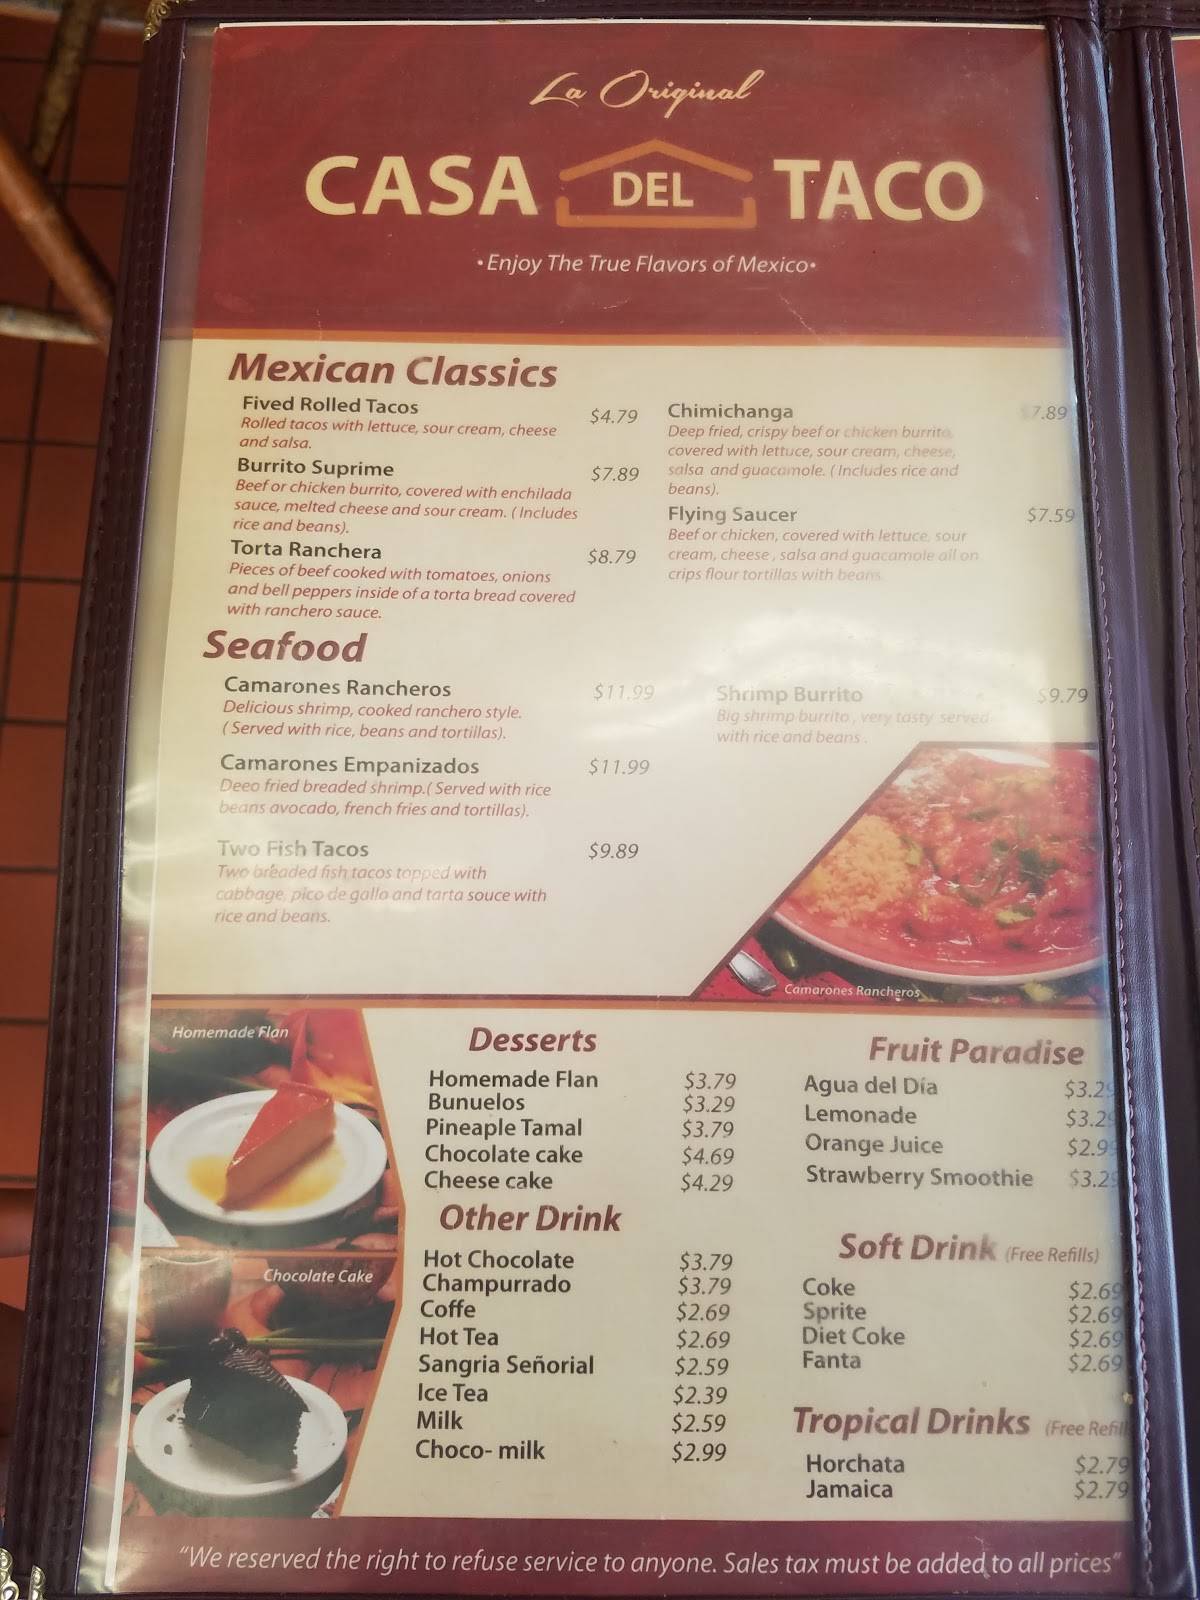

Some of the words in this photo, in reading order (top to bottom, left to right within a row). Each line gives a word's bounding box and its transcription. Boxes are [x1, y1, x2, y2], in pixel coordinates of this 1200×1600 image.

[529, 72, 586, 106] La
[600, 70, 764, 118] Original
[306, 156, 536, 215] CASA
[612, 170, 694, 207] DEL
[774, 160, 984, 221] TACO
[548, 254, 583, 272] The
[589, 254, 631, 272] True
[636, 255, 707, 273] Flavors
[712, 255, 736, 272] of
[229, 353, 394, 383] Mexican
[406, 356, 557, 387] Classics
[242, 396, 294, 411] Fived
[300, 397, 361, 413] Rolled
[365, 399, 418, 414] Tacos
[668, 403, 793, 422] Chimichanga
[1020, 404, 1068, 421] 7.89
[590, 408, 638, 424] $4.79
[240, 416, 287, 429] Rolled
[289, 420, 328, 431] tacos
[332, 420, 364, 432] with
[367, 420, 418, 434] lettuce,
[422, 424, 455, 434] sour
[457, 425, 505, 436] cream,
[508, 424, 557, 437] cheese
[239, 436, 270, 448] and
[271, 436, 312, 449] salsa.
[237, 457, 306, 474] Burrito
[312, 460, 394, 478] Suprime
[591, 466, 640, 482] $7.89
[668, 506, 726, 526] Flying
[732, 507, 798, 522] Saucer
[1027, 507, 1075, 524] $7.59
[230, 539, 282, 556] Torta
[289, 542, 382, 559] Ranchera
[587, 549, 637, 564] $8.79
[204, 630, 367, 662] Seafood
[224, 676, 340, 694] Camarones
[347, 680, 451, 697] Rancheros
[593, 683, 655, 701] $11.99
[716, 685, 788, 706] Shrimp
[794, 686, 864, 702] Burrito
[1037, 687, 1089, 704] $9.79
[223, 700, 294, 714] Delicious
[297, 702, 354, 718] shrimp,
[357, 704, 413, 717] cooked
[415, 705, 482, 718] ranchero
[485, 706, 522, 722] style.
[220, 754, 338, 772] Camarones
[344, 756, 479, 776] Empanizados
[588, 758, 650, 775] $11.99
[217, 840, 260, 857] Two
[266, 840, 307, 856] Fish
[312, 840, 369, 857] Tacos
[588, 842, 639, 860] $9.89
[784, 984, 853, 996] Camarones
[856, 985, 921, 999] Rancheros
[172, 1026, 255, 1038] Homemade
[258, 1025, 289, 1038] Flan
[469, 1027, 596, 1052] Desserts
[869, 1036, 942, 1062] Fruit
[950, 1039, 1084, 1065] Paradise
[429, 1070, 550, 1088] Homemade
[556, 1070, 598, 1088] Flan
[684, 1072, 737, 1090] $3.79
[804, 1075, 858, 1097] Agua
[864, 1076, 897, 1094] del
[903, 1077, 938, 1095] Día
[428, 1093, 525, 1111] Bunuelos
[683, 1094, 736, 1114] $3.29
[805, 1105, 917, 1124] Lemonade
[426, 1118, 516, 1140] Pineaple
[520, 1118, 582, 1136] Tamal
[682, 1119, 734, 1138] $3.79
[425, 1144, 530, 1163] Chocolate
[535, 1145, 583, 1163] cake
[805, 1133, 884, 1157] Orange
[890, 1136, 944, 1154] Juice
[682, 1146, 735, 1166] $4.69
[424, 1170, 500, 1189] Cheese
[505, 1171, 553, 1190] cake
[680, 1173, 734, 1192] $4.29
[806, 1165, 924, 1189] Strawberry
[930, 1168, 1033, 1187] Smoothie
[440, 1204, 529, 1231] Other
[536, 1205, 621, 1231] Drink
[839, 1233, 903, 1260] Soft
[910, 1235, 996, 1260] Drink
[1004, 1246, 1044, 1263] (Free
[1047, 1247, 1100, 1264] Refills)
[424, 1250, 462, 1268] Hot
[468, 1250, 574, 1269] Chocolate
[679, 1252, 733, 1272] $3.79
[263, 1268, 335, 1282] Chocolate
[338, 1270, 374, 1283] Cake
[422, 1273, 571, 1296] Champurrado
[678, 1276, 732, 1296] $3.79
[802, 1277, 856, 1296] Coke
[1069, 1280, 1122, 1301] $2.69
[420, 1299, 476, 1318] Coffe
[676, 1302, 730, 1322] $2.69
[803, 1302, 867, 1324] Sprite
[1068, 1304, 1122, 1325] $2.69
[420, 1327, 458, 1346] Hot
[462, 1327, 499, 1346] Tea
[676, 1329, 731, 1350] $2.69
[802, 1326, 846, 1345] Diet
[852, 1327, 906, 1345] Coke
[1069, 1328, 1123, 1350] $2.69
[418, 1354, 500, 1378] Sangria
[506, 1355, 594, 1374] Señorial
[675, 1356, 729, 1376] $2.59
[802, 1350, 862, 1369] Fanta
[1068, 1352, 1122, 1374] $2.69
[418, 1383, 448, 1402] Ice
[452, 1383, 488, 1402] Tea
[673, 1385, 728, 1405] $2.39
[416, 1410, 463, 1430] Milk
[672, 1413, 726, 1434] $2.59
[794, 1407, 920, 1439] Tropical
[927, 1407, 1030, 1435] Drinks
[1044, 1420, 1085, 1436] (Free
[1088, 1420, 1130, 1437] Refill
[498, 1440, 545, 1460] milk
[672, 1442, 727, 1463] $2.99
[806, 1454, 905, 1473] Horchata
[1074, 1454, 1129, 1475] $2.79
[806, 1479, 893, 1498] Jamaica
[1073, 1479, 1129, 1500] $2.79
[227, 1548, 321, 1569] reserved
[326, 1548, 361, 1570] the
[366, 1548, 420, 1576] right
[425, 1552, 447, 1571] to
[452, 1549, 518, 1571] refuse
[523, 1552, 598, 1572] service
[604, 1554, 625, 1572] to
[631, 1557, 716, 1578] anyone.
[723, 1552, 779, 1574] Sales
[785, 1556, 820, 1574] tax
[825, 1556, 880, 1574] must
[885, 1552, 912, 1574] be
[917, 1551, 986, 1575] added
[991, 1553, 1013, 1575] to
[1018, 1551, 1045, 1573] all
